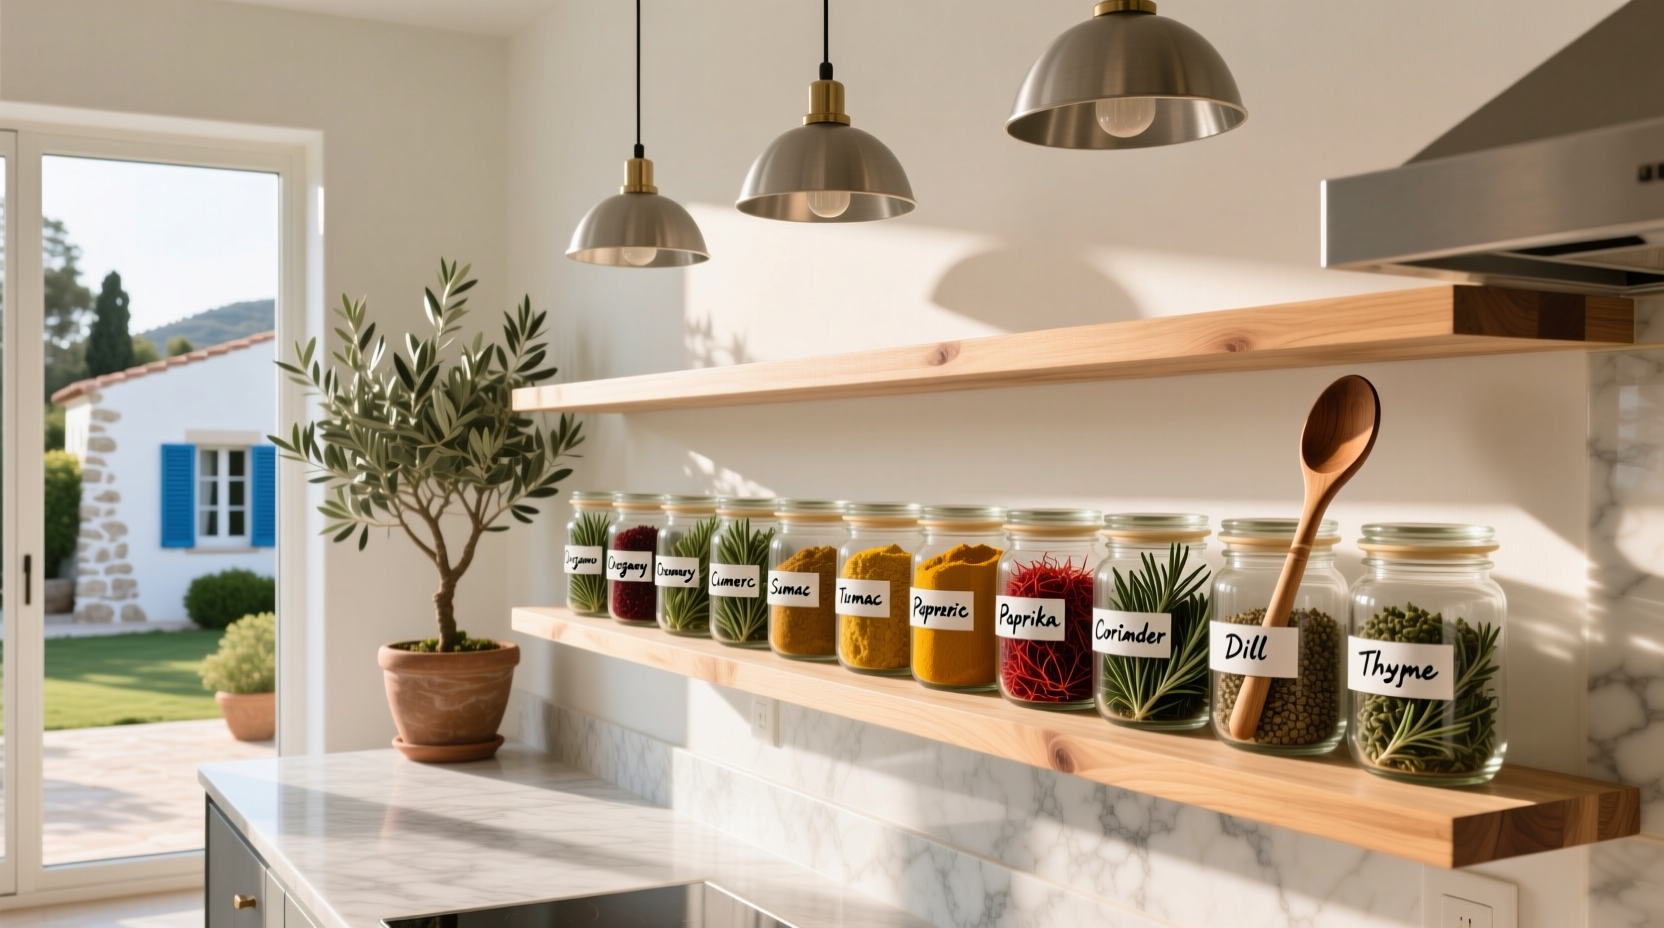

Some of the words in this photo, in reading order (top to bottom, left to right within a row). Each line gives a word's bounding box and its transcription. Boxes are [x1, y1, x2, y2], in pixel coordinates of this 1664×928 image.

[839, 587, 883, 606] Tumac
[1000, 603, 1061, 635] Paprika
[1225, 633, 1268, 661] Dill
[1358, 650, 1439, 688] Thyme
